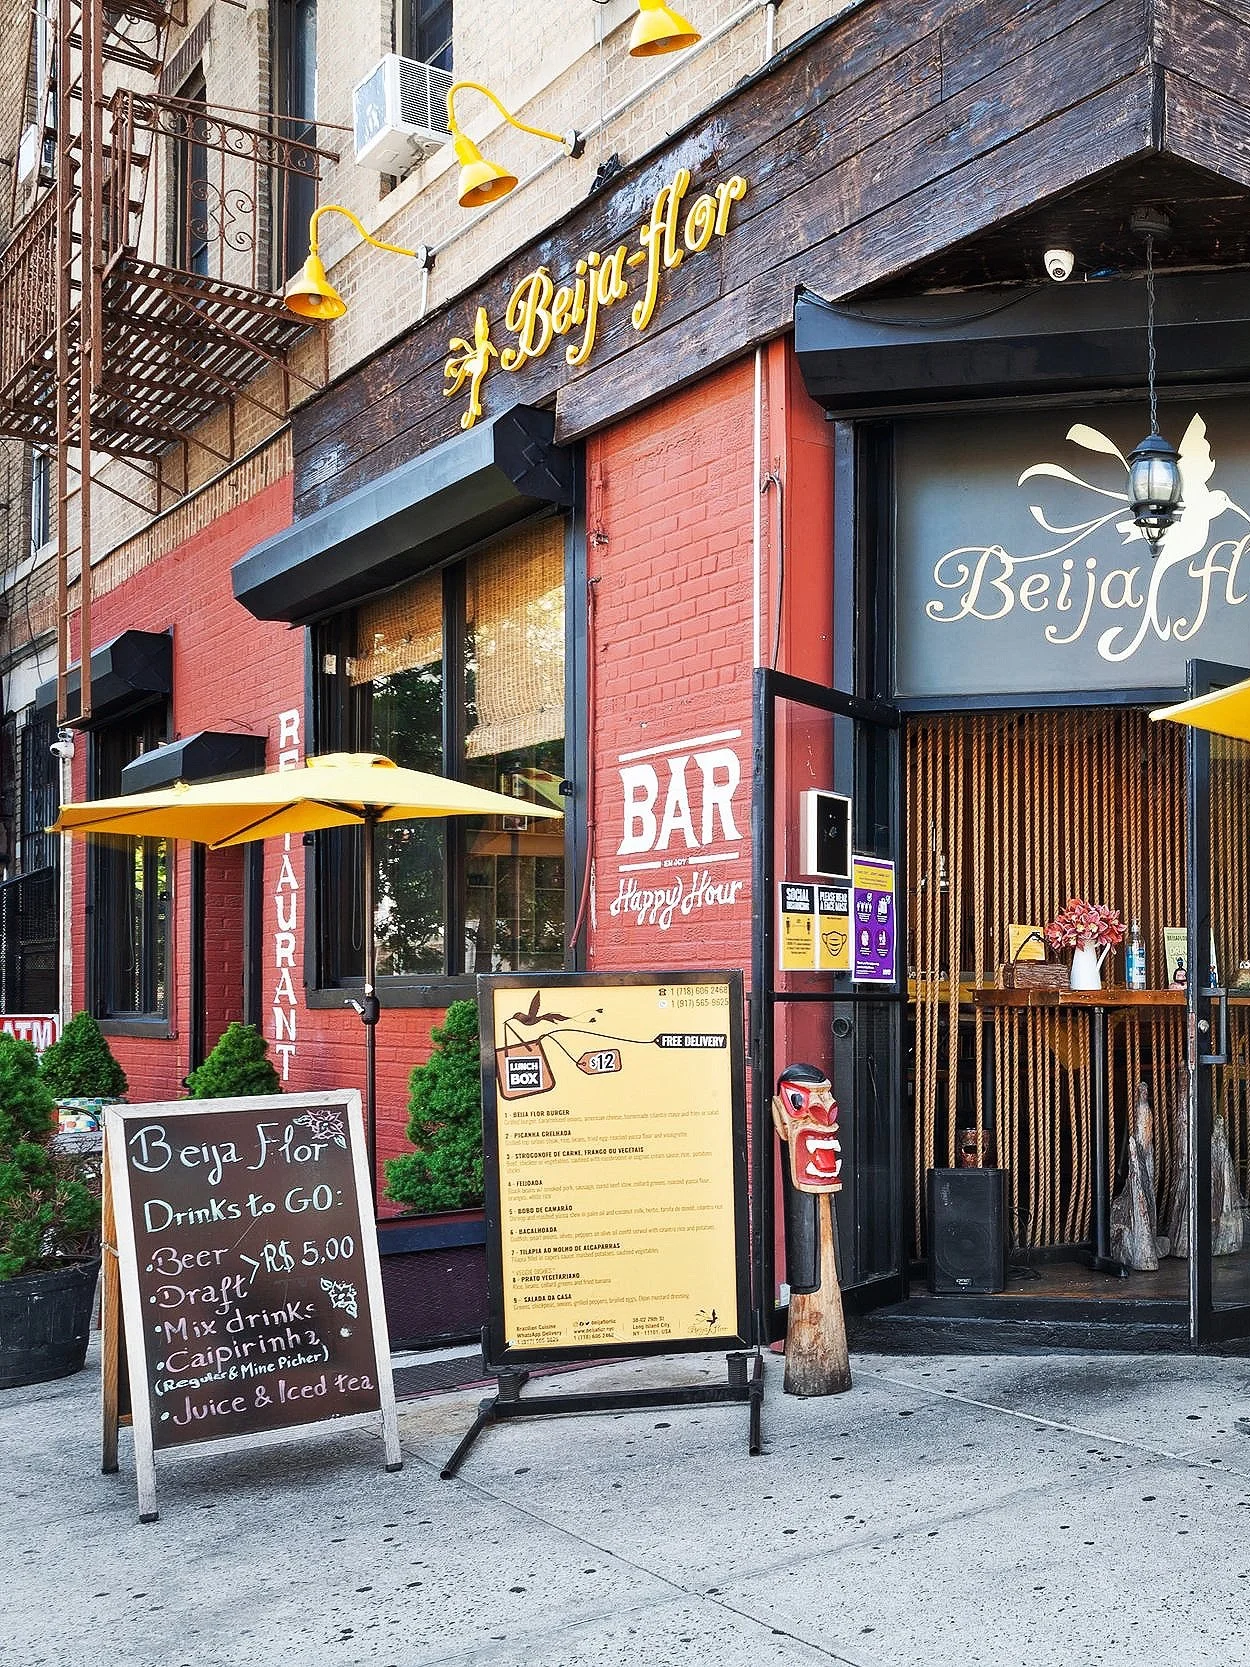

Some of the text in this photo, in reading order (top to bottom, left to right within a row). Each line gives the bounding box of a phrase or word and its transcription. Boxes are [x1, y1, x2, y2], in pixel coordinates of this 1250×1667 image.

[501, 168, 747, 371] Beija-flor
[925, 545, 1143, 645] Beija
[616, 746, 744, 856] BAR
[610, 869, 743, 931] Happy Hour
[591, 1053, 614, 1070] $12
[661, 1035, 725, 1047] FREE DELIVERY
[509, 1062, 539, 1071] LUNCH
[510, 1073, 539, 1085] BOX
[247, 1122, 329, 1170] Flor
[144, 1198, 242, 1233] Drinks
[247, 1194, 276, 1217] to
[152, 1247, 229, 1276] Beer
[301, 1235, 354, 1266] 5,00
[156, 1274, 248, 1315] Draft
[164, 1301, 315, 1344] Mix drinks
[165, 1327, 321, 1374] Caipirinha
[173, 1375, 375, 1425] Juice & Iced tea
